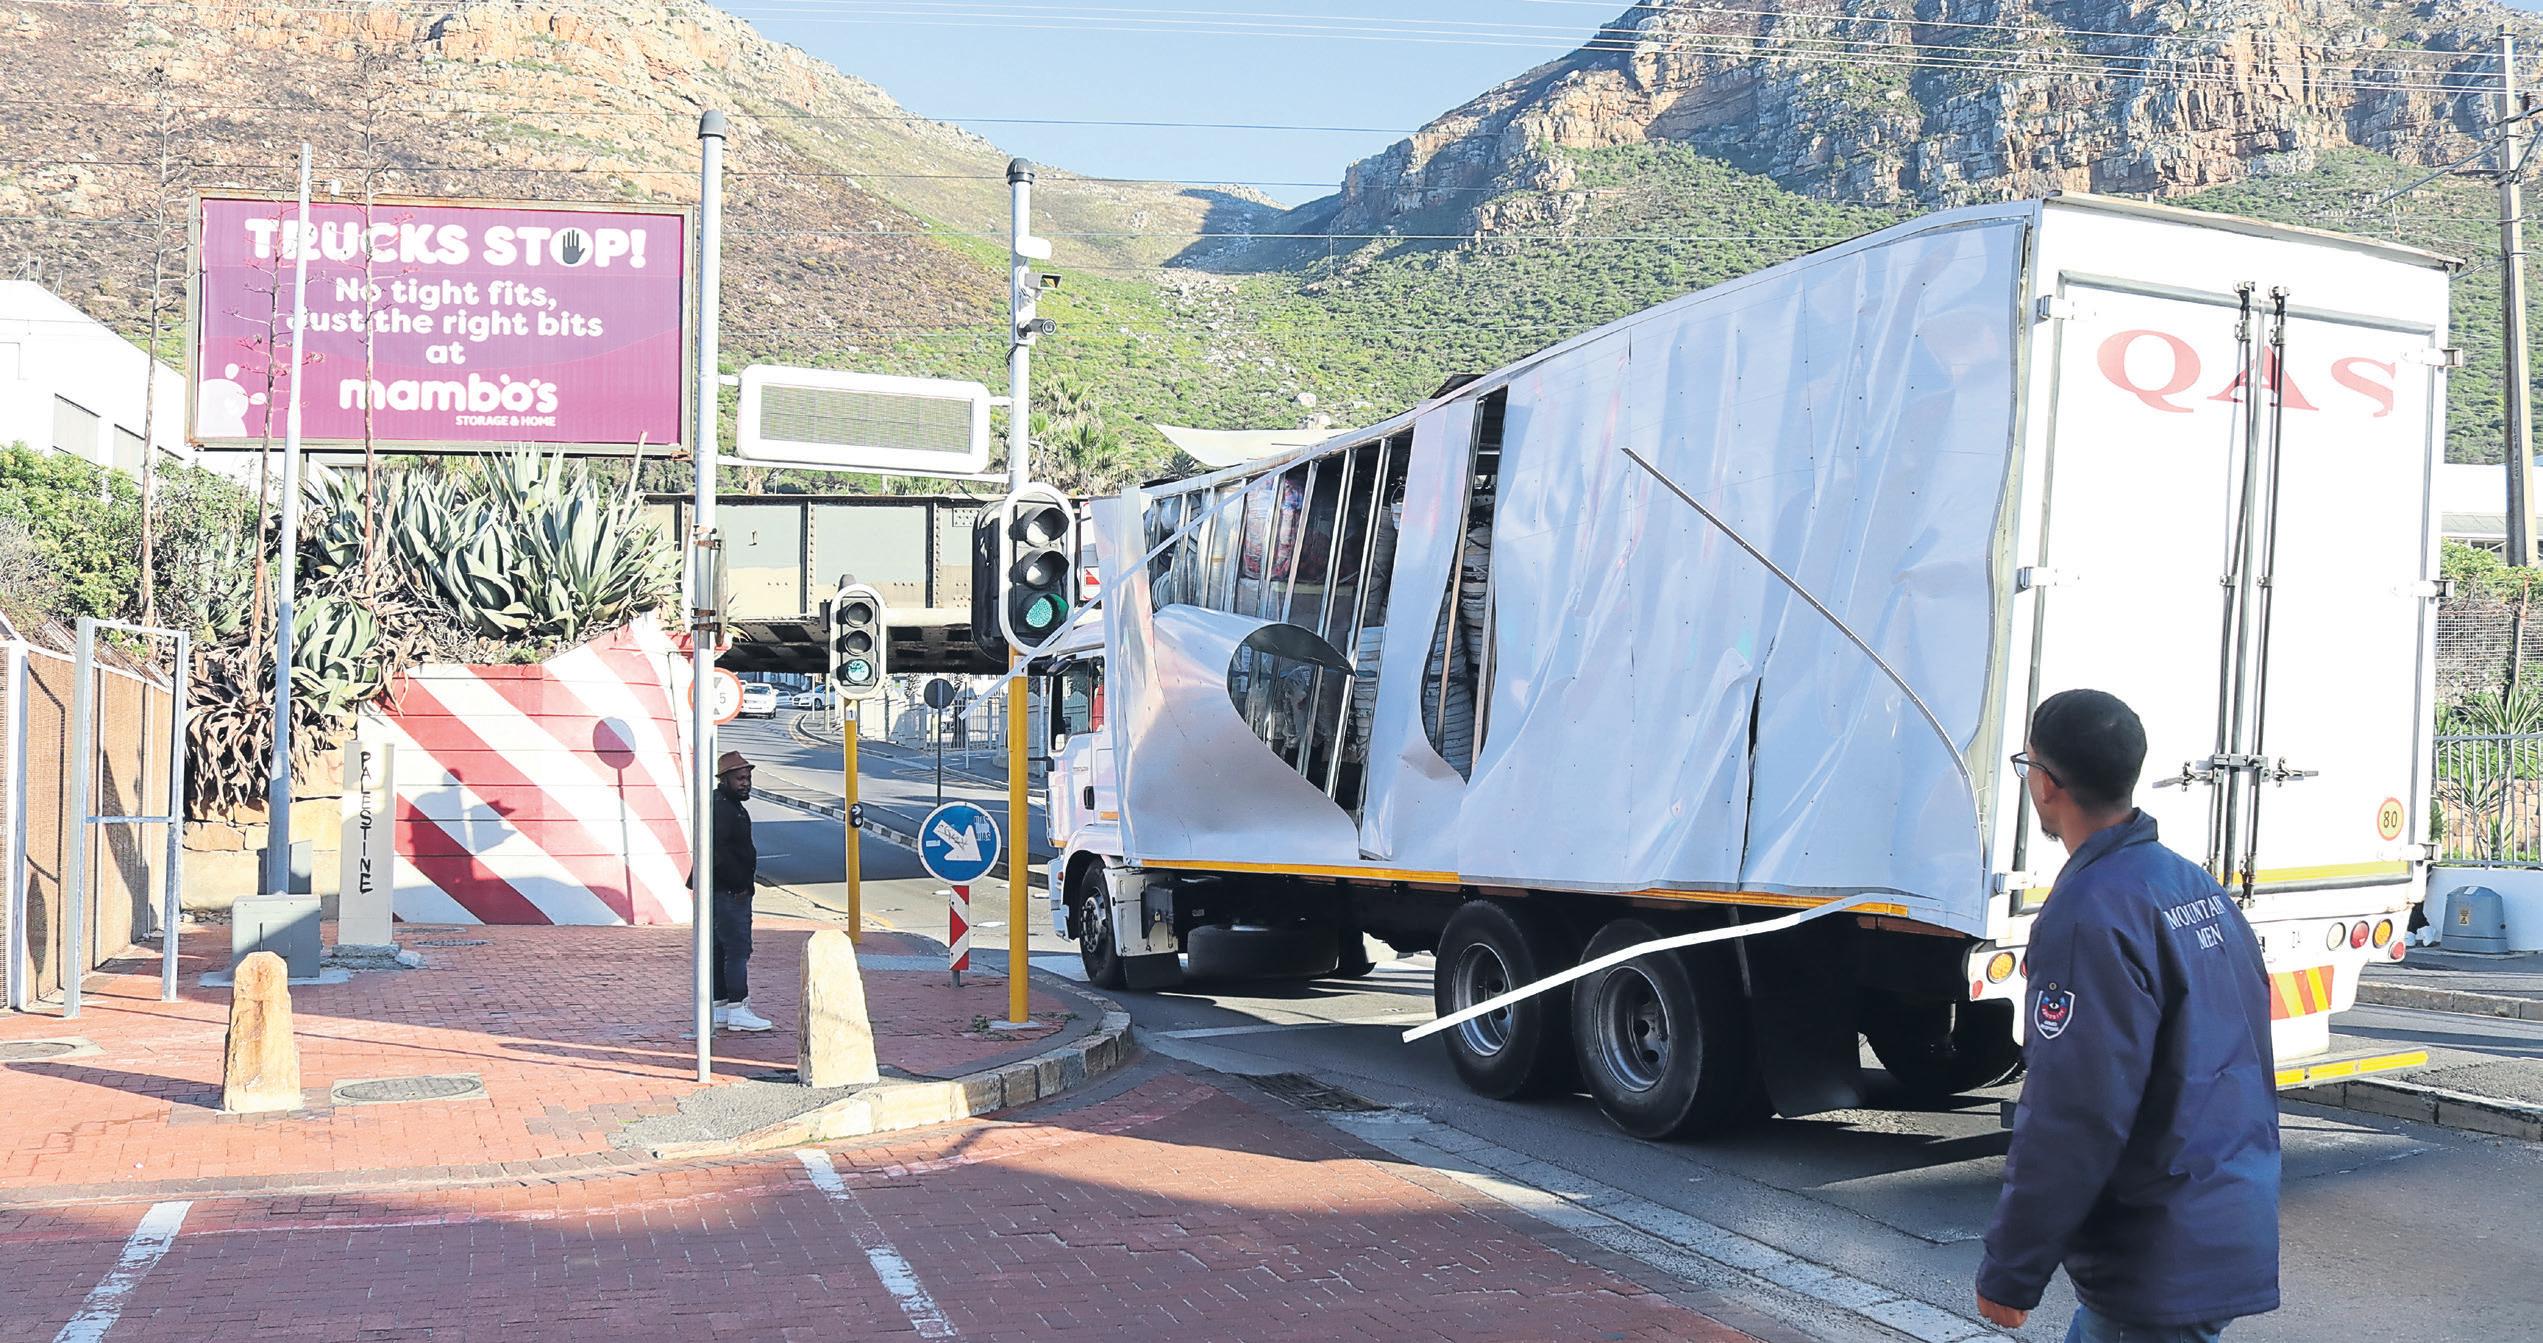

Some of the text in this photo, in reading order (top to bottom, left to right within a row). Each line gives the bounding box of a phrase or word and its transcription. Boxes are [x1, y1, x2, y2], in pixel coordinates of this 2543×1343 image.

[244, 218, 647, 269] TRUCKS STOP!
[335, 277, 558, 311] No tight fits,
[373, 308, 434, 334] the
[442, 308, 529, 342] right
[538, 310, 604, 337] bits
[425, 341, 466, 364] at
[2097, 329, 2396, 418] QAS
[455, 415, 557, 427] STORAGE & HOME
[360, 751, 373, 895] PALESTINE
[2383, 810, 2398, 828] 80
[2195, 922, 2224, 950] MEN
